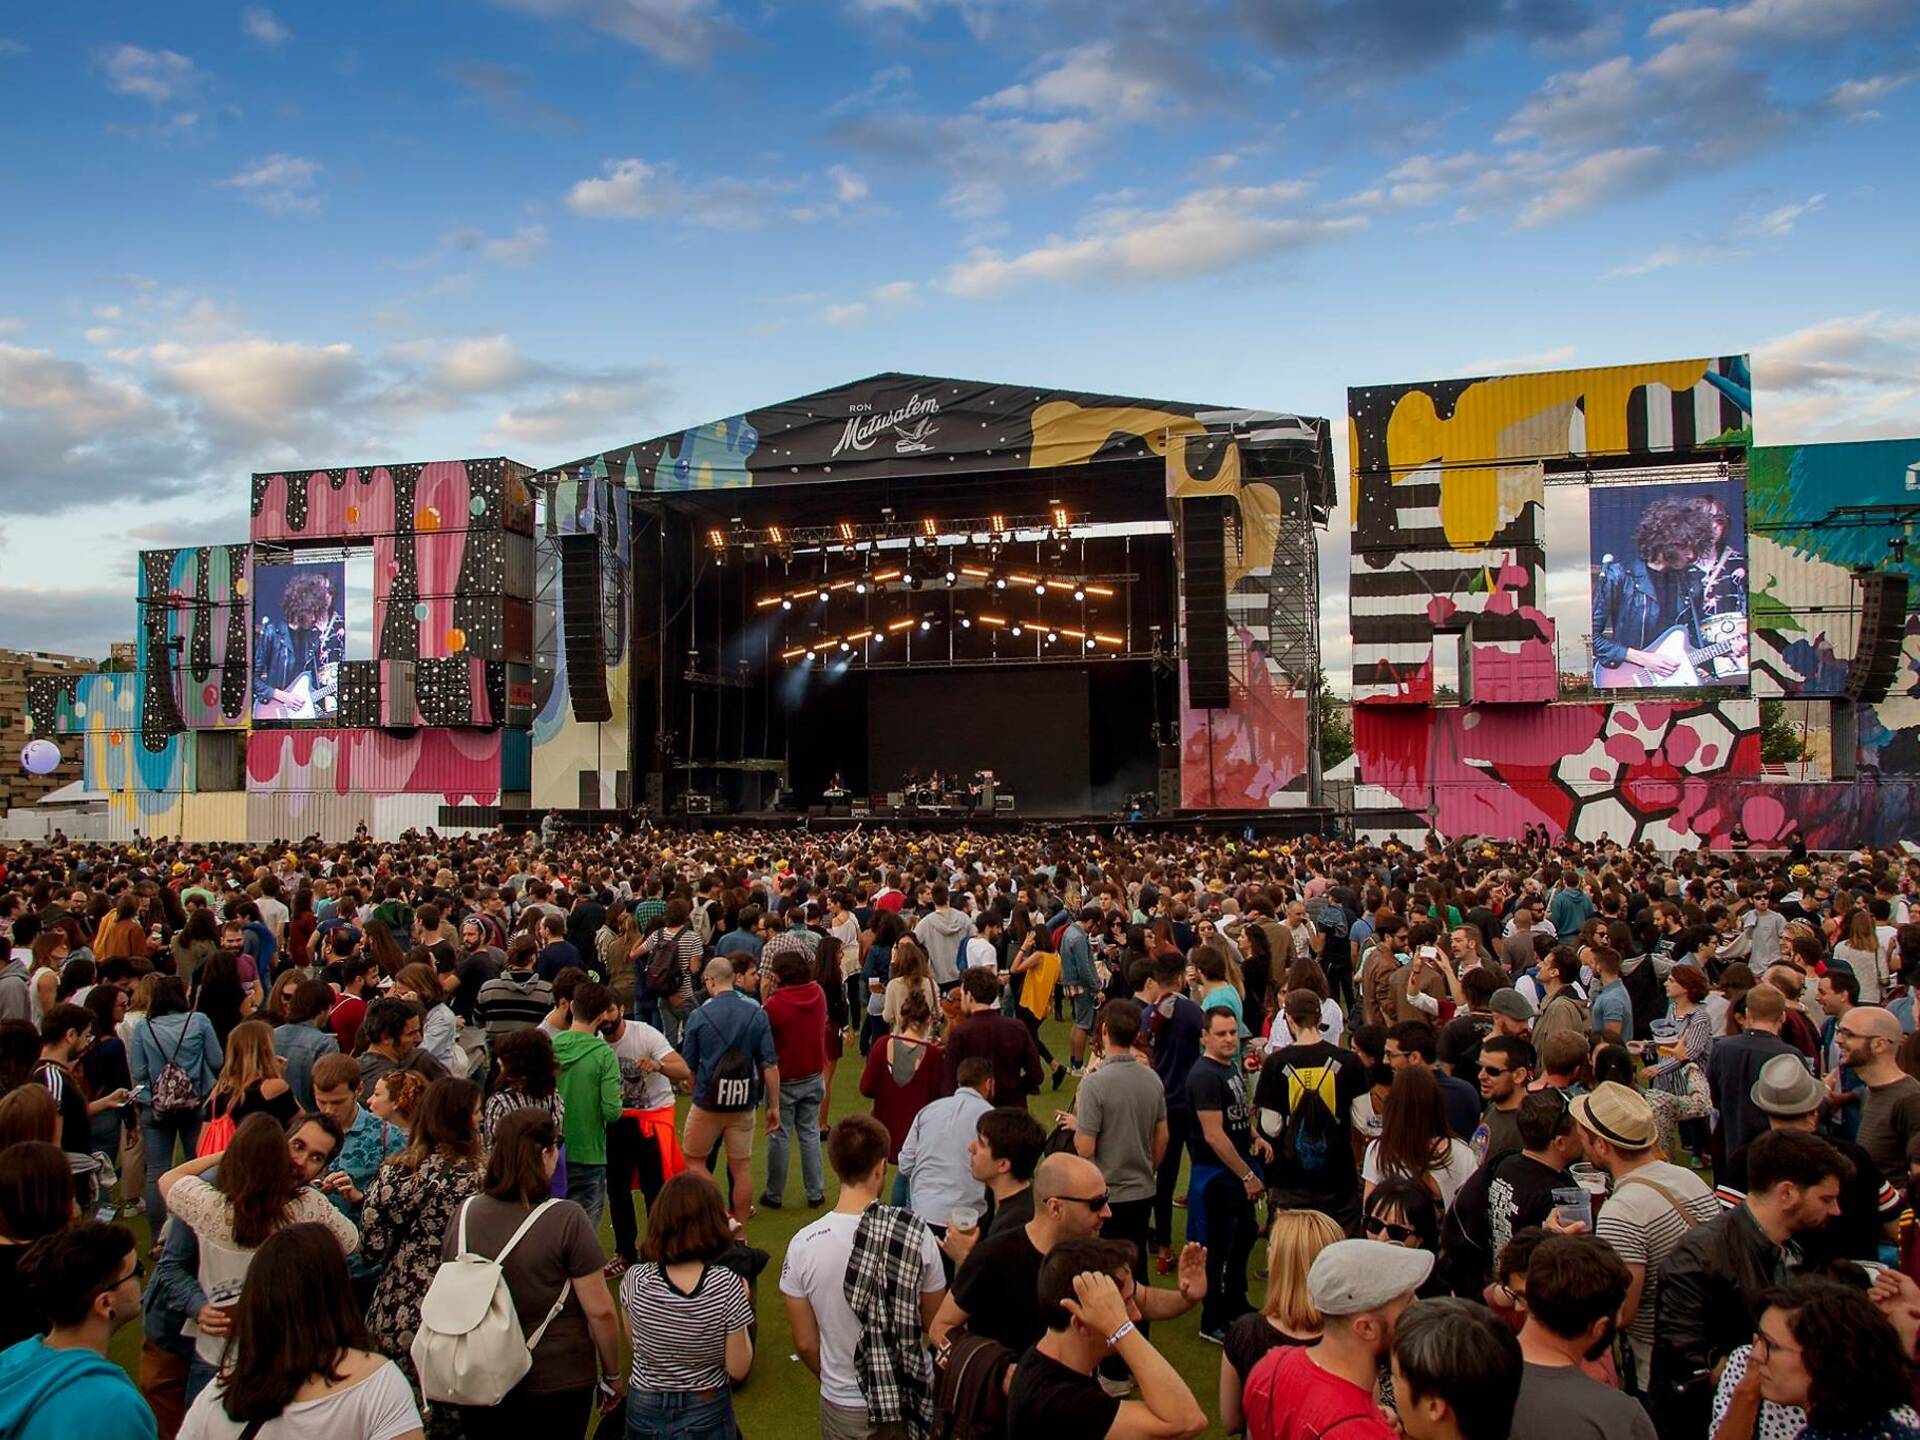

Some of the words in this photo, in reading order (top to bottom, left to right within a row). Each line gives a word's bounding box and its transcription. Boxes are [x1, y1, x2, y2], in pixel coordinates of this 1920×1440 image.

[849, 403, 873, 412] RON
[831, 393, 940, 457] Matusalem
[717, 1078, 750, 1106] FIAT
